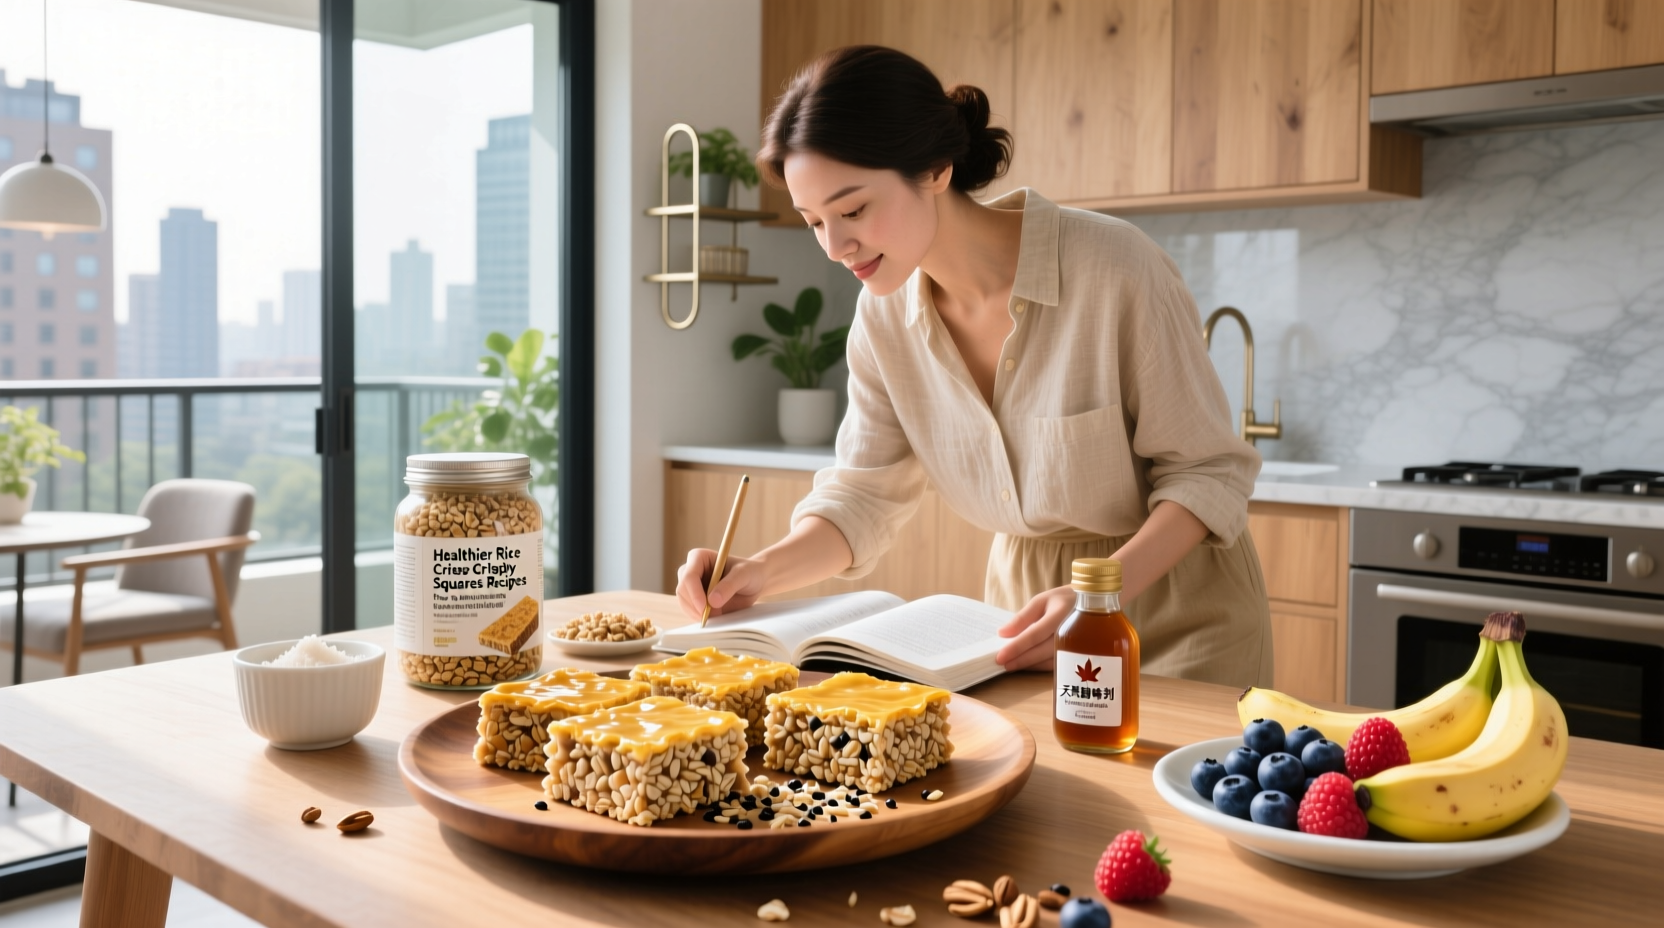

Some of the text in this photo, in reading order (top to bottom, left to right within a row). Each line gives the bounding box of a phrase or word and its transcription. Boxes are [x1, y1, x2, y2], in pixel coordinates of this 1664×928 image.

[433, 546, 521, 562] Healthier Rice
[433, 575, 527, 592] Squares Recipes
